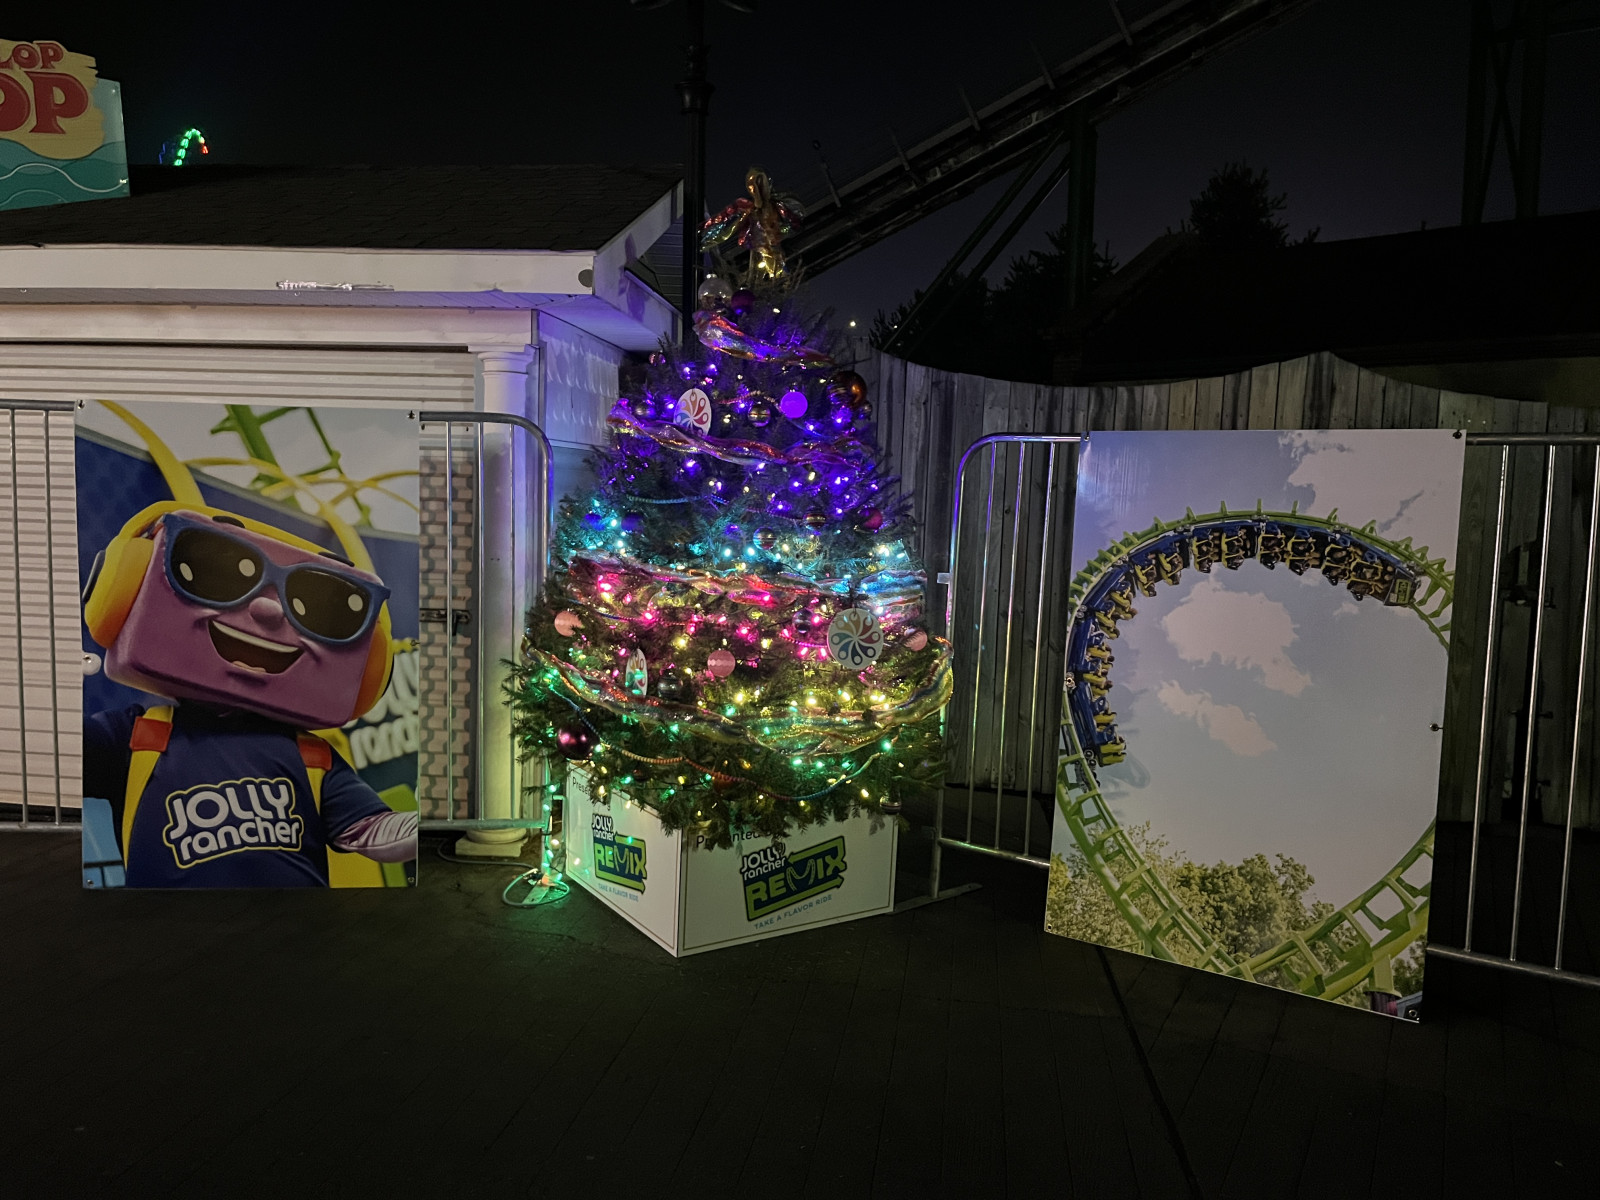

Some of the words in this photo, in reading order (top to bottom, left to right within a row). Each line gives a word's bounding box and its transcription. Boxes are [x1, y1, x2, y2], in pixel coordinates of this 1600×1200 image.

[170, 784, 291, 840] JOLLY
[592, 815, 612, 831] JOLLY
[181, 816, 300, 861] rancher
[593, 829, 614, 841] rancher
[595, 843, 647, 879] REMIX
[744, 857, 785, 880] rancher
[746, 855, 847, 902] REMIX
[754, 917, 774, 930] TAKE
[776, 914, 782, 923] A
[784, 901, 813, 917] FLAVOR
[815, 894, 832, 905] RIDE
